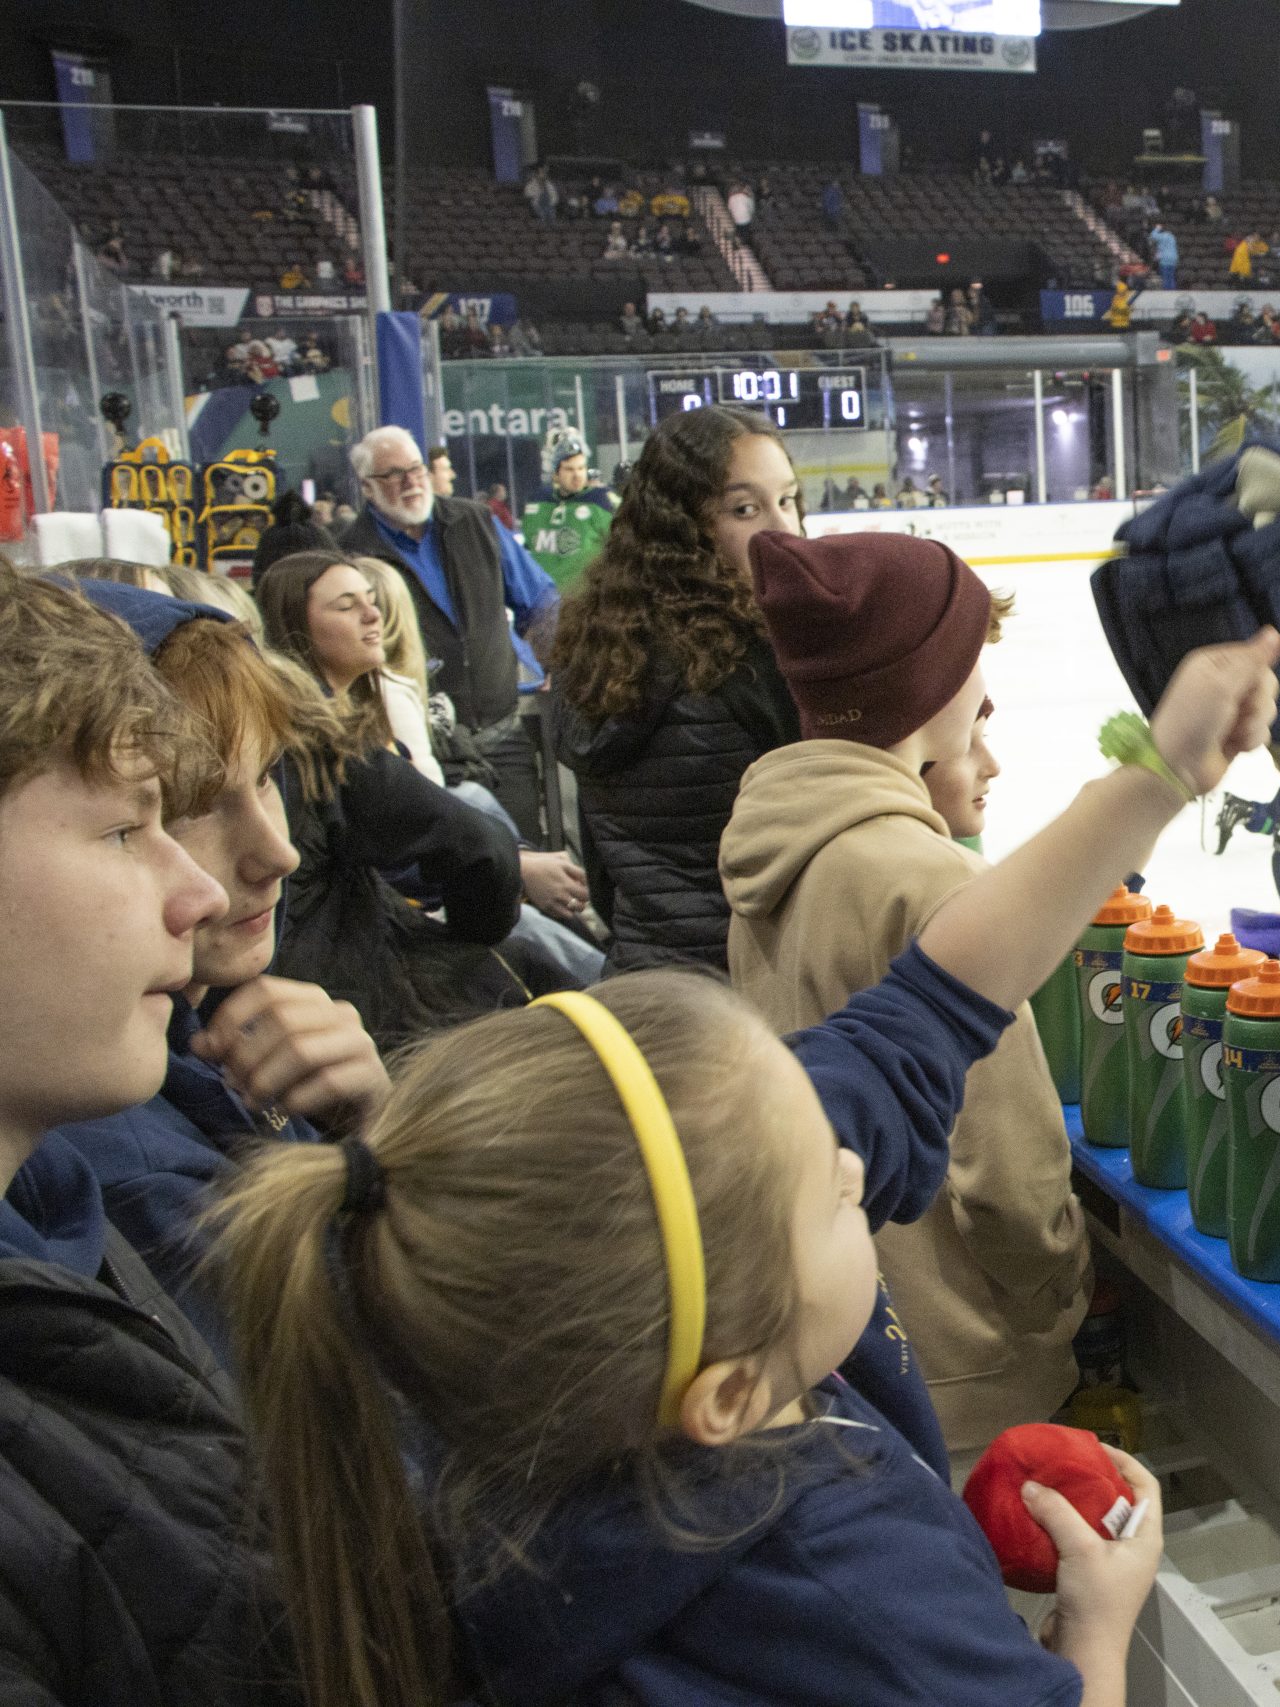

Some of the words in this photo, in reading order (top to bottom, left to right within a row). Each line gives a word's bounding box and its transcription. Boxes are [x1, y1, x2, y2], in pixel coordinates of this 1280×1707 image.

[828, 30, 873, 51] ICE
[883, 31, 995, 55] SKATING
[1063, 294, 1094, 317] 106
[659, 378, 697, 394] HOME
[817, 375, 856, 389] GUEST
[841, 390, 860, 420] 0
[443, 402, 569, 437] entara
[1131, 981, 1152, 1000] 17
[1224, 1046, 1243, 1069] 14
